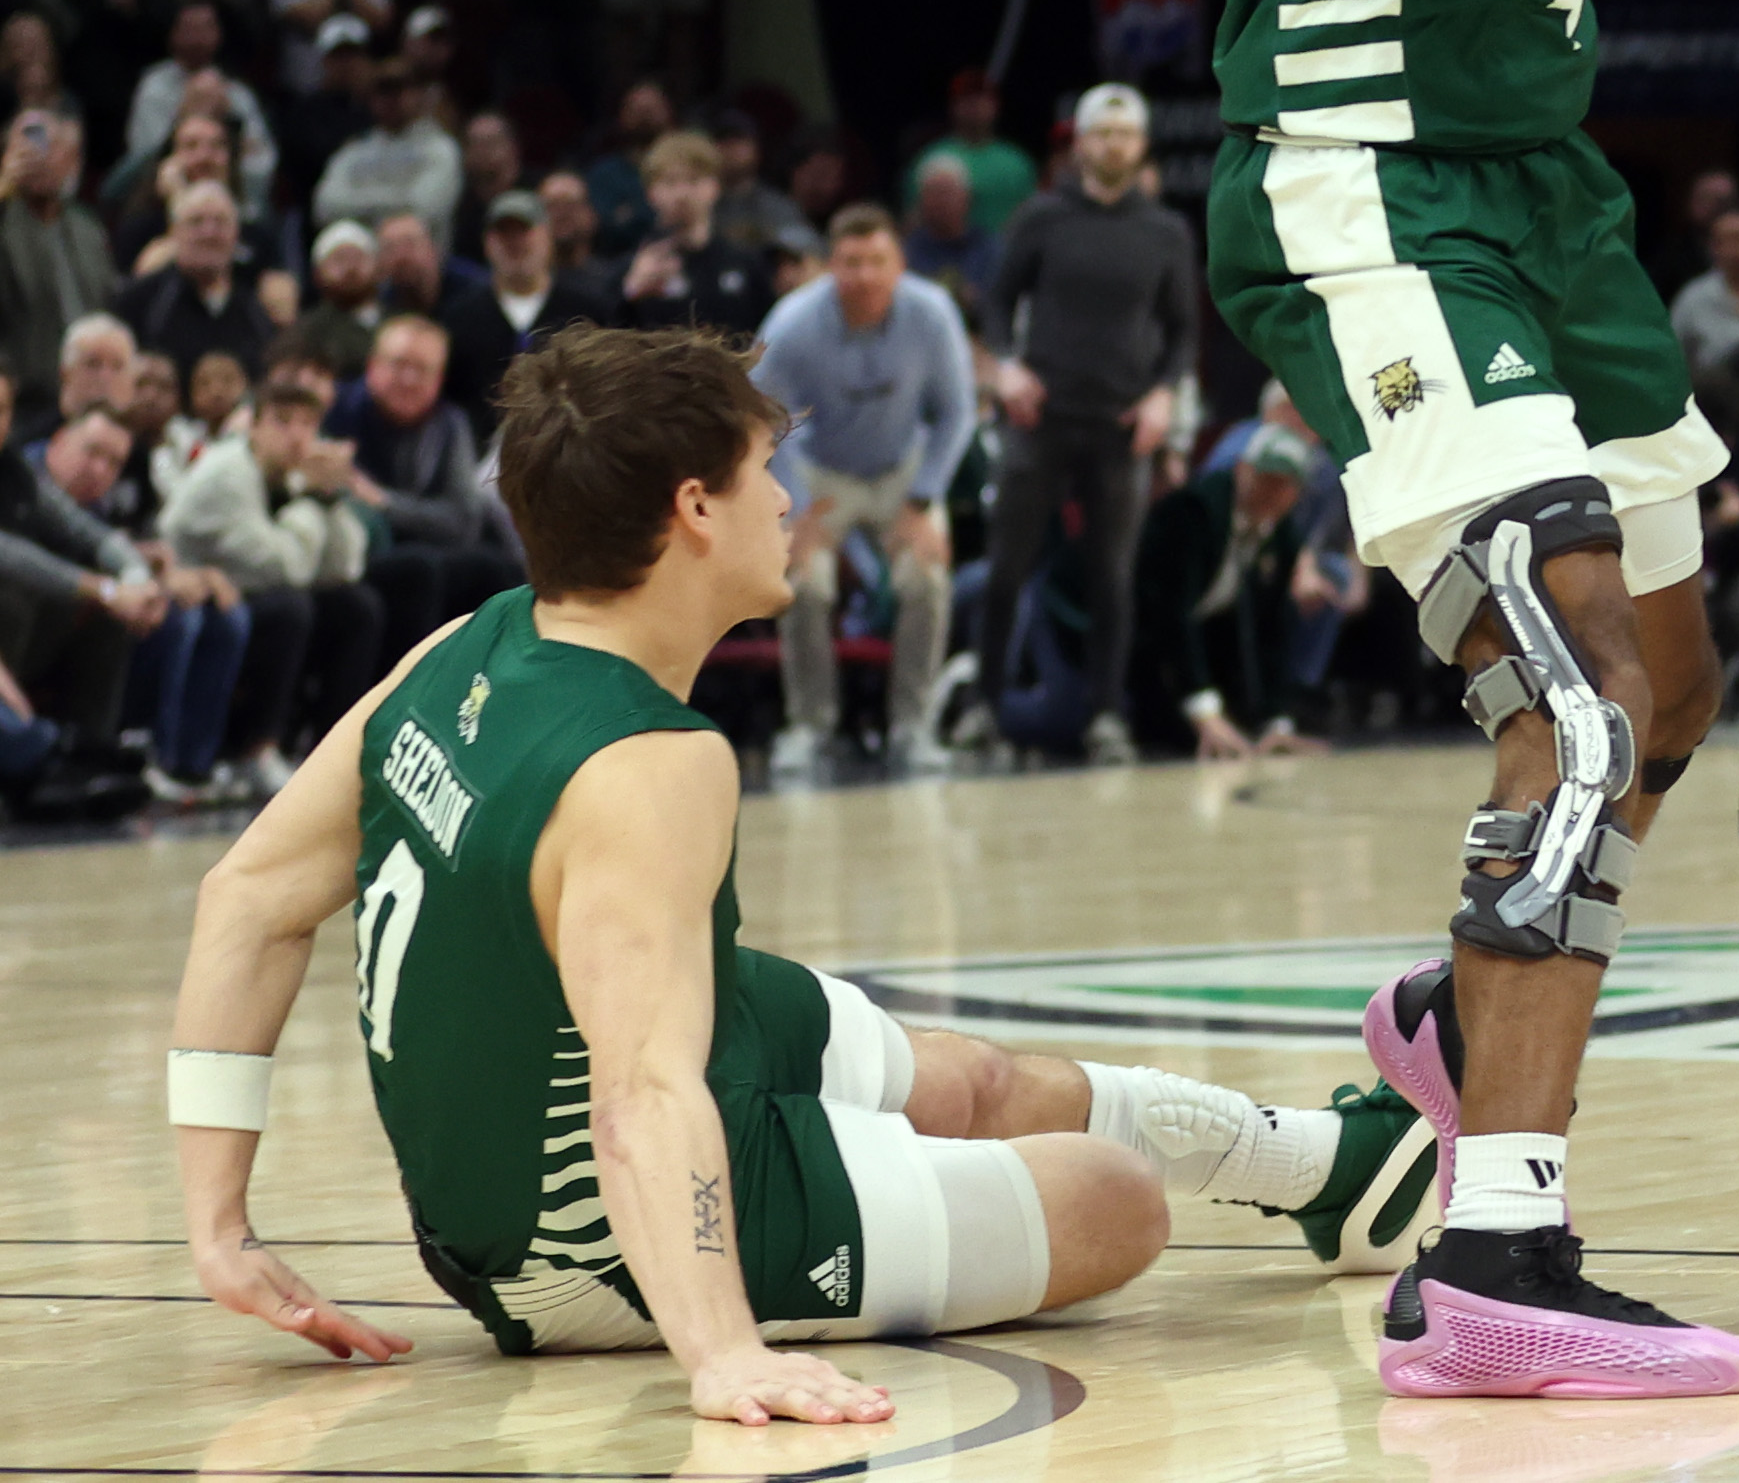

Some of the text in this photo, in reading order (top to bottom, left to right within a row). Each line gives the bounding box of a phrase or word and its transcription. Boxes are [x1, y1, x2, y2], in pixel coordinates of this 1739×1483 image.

[1483, 363, 1537, 385] adidas
[1498, 593, 1534, 654] TITANIUM
[835, 1244, 850, 1307] adidas
